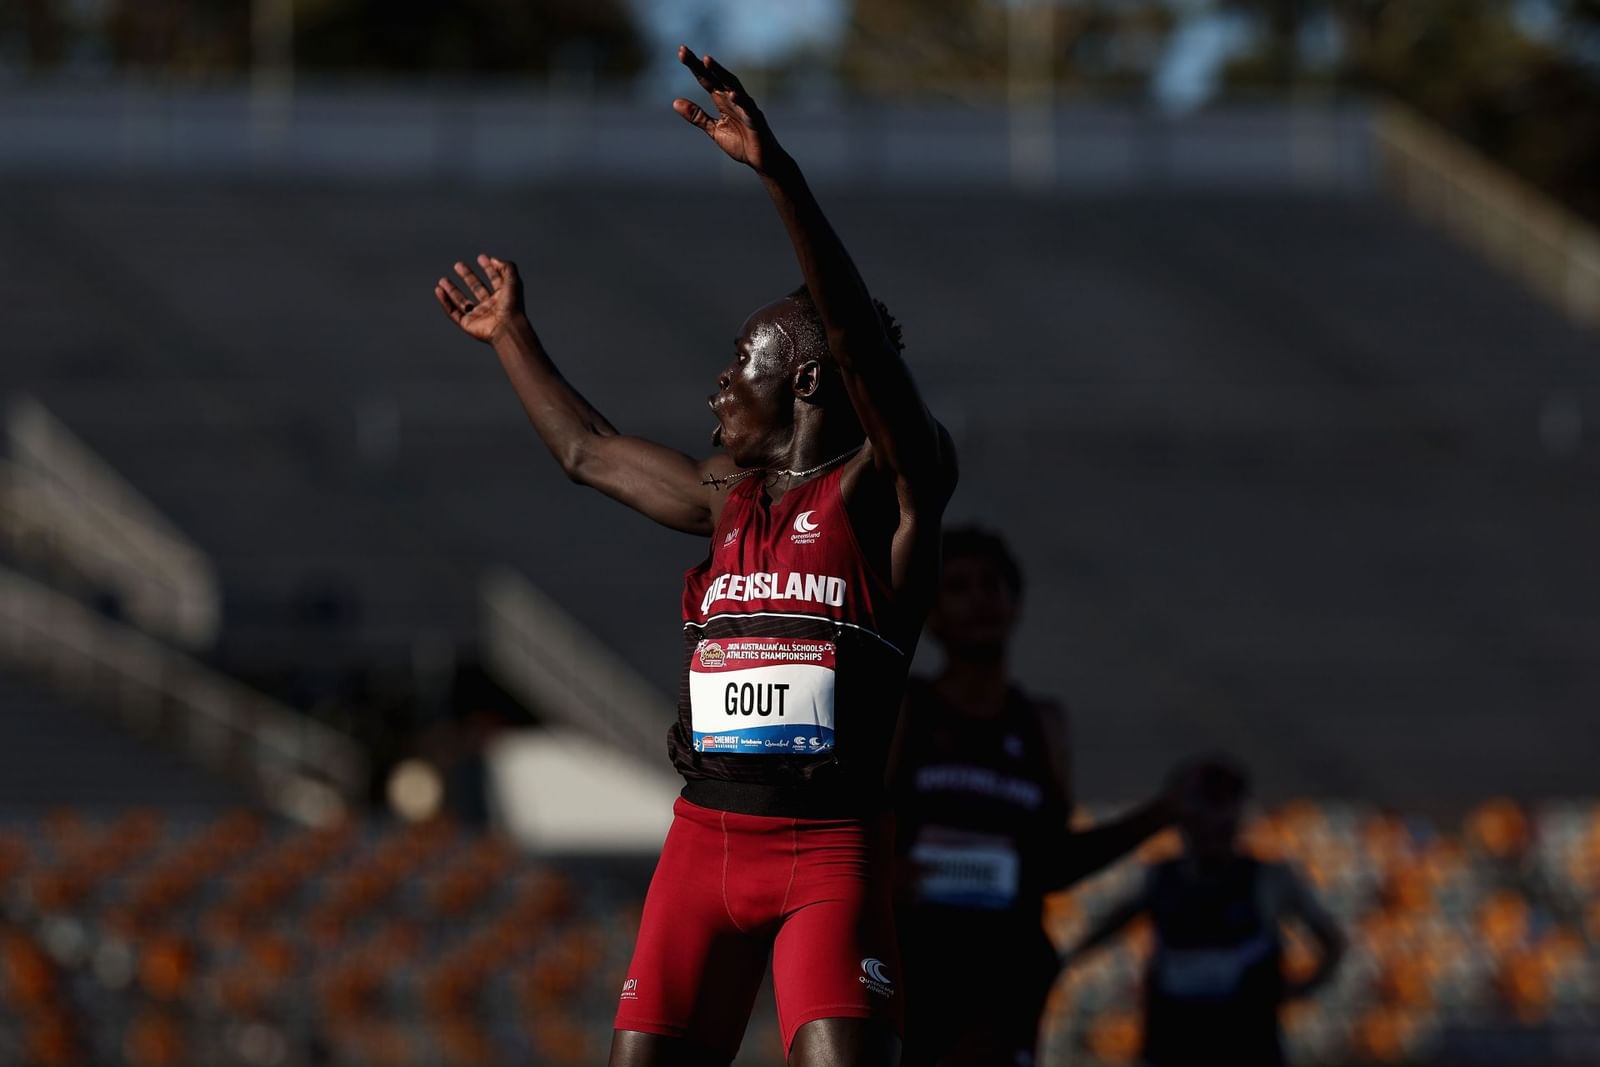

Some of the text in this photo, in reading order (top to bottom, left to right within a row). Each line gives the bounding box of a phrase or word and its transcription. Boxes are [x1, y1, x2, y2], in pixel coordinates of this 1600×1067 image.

[790, 531, 821, 541] Queensland
[700, 572, 847, 615] QUEENSLAND
[740, 642, 778, 651] AUSTRALIAN
[778, 643, 791, 651] ALL
[792, 644, 824, 652] SCHOOLS
[726, 651, 823, 661] ATHLETICS CHAMPIONSHIPS
[724, 682, 790, 717] GOUT
[714, 735, 740, 744] CHEMIST
